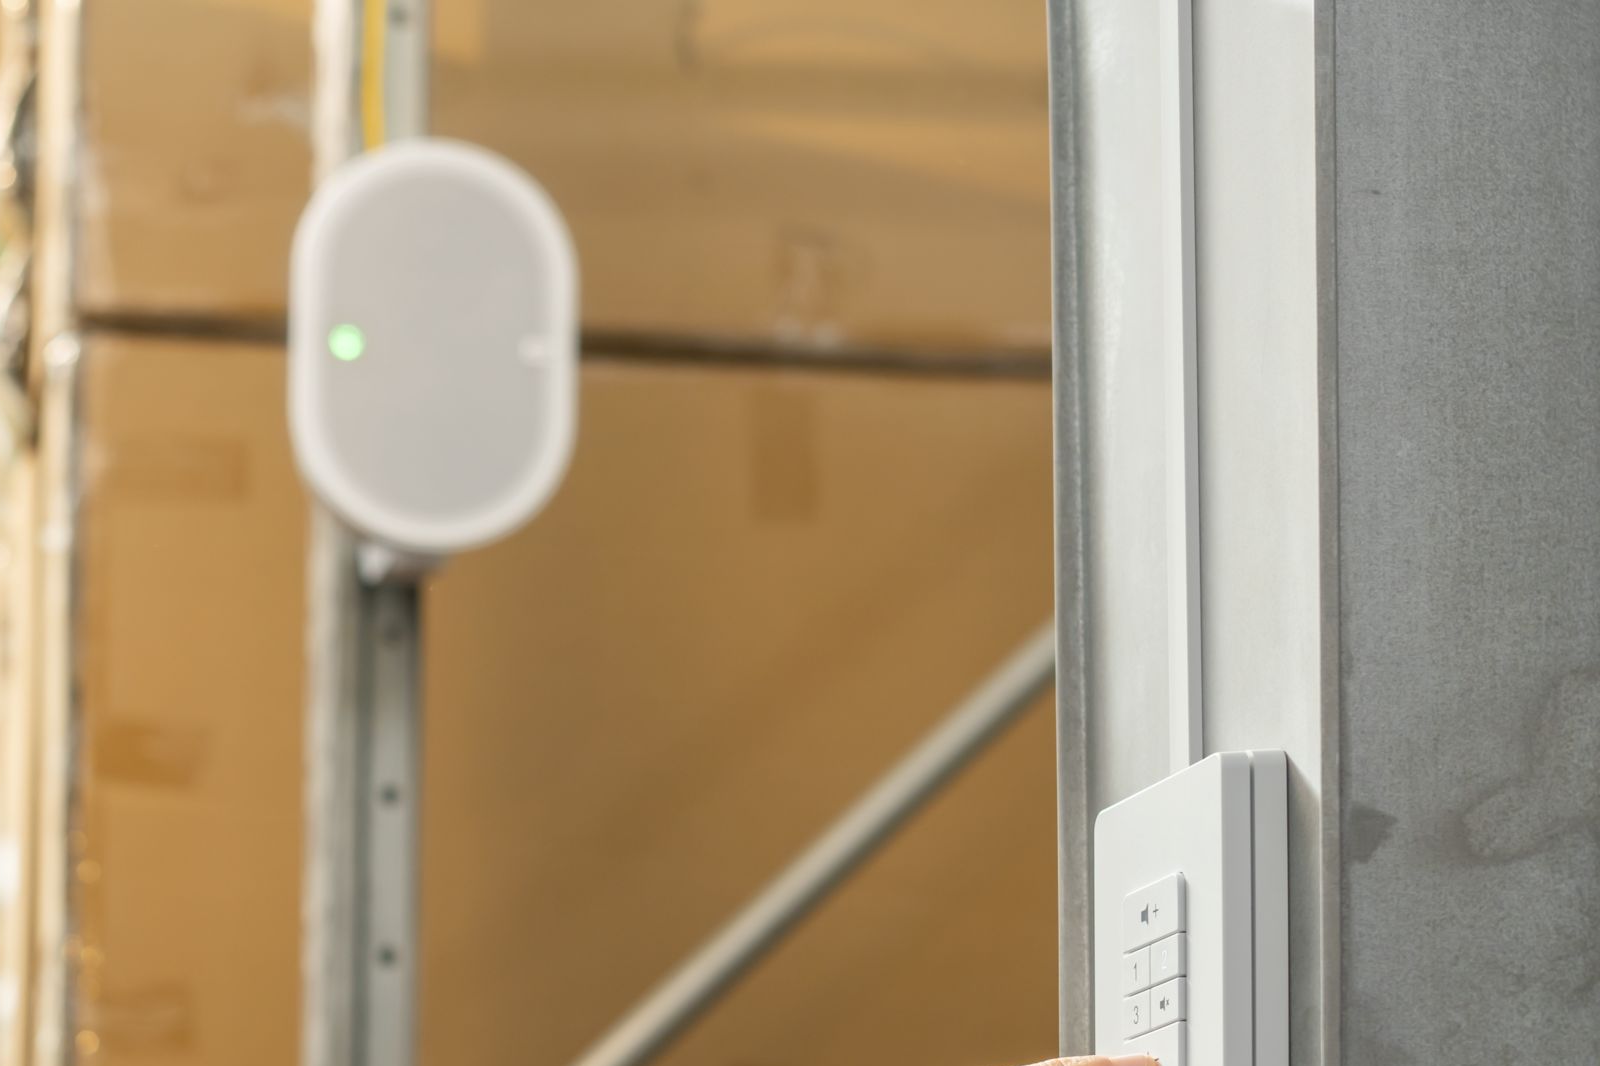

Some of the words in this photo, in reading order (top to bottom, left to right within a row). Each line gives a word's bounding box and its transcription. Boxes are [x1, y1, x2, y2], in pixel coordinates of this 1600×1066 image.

[1161, 949, 1168, 970] 2
[1133, 962, 1139, 983] 1
[1133, 1005, 1139, 1025] 3
